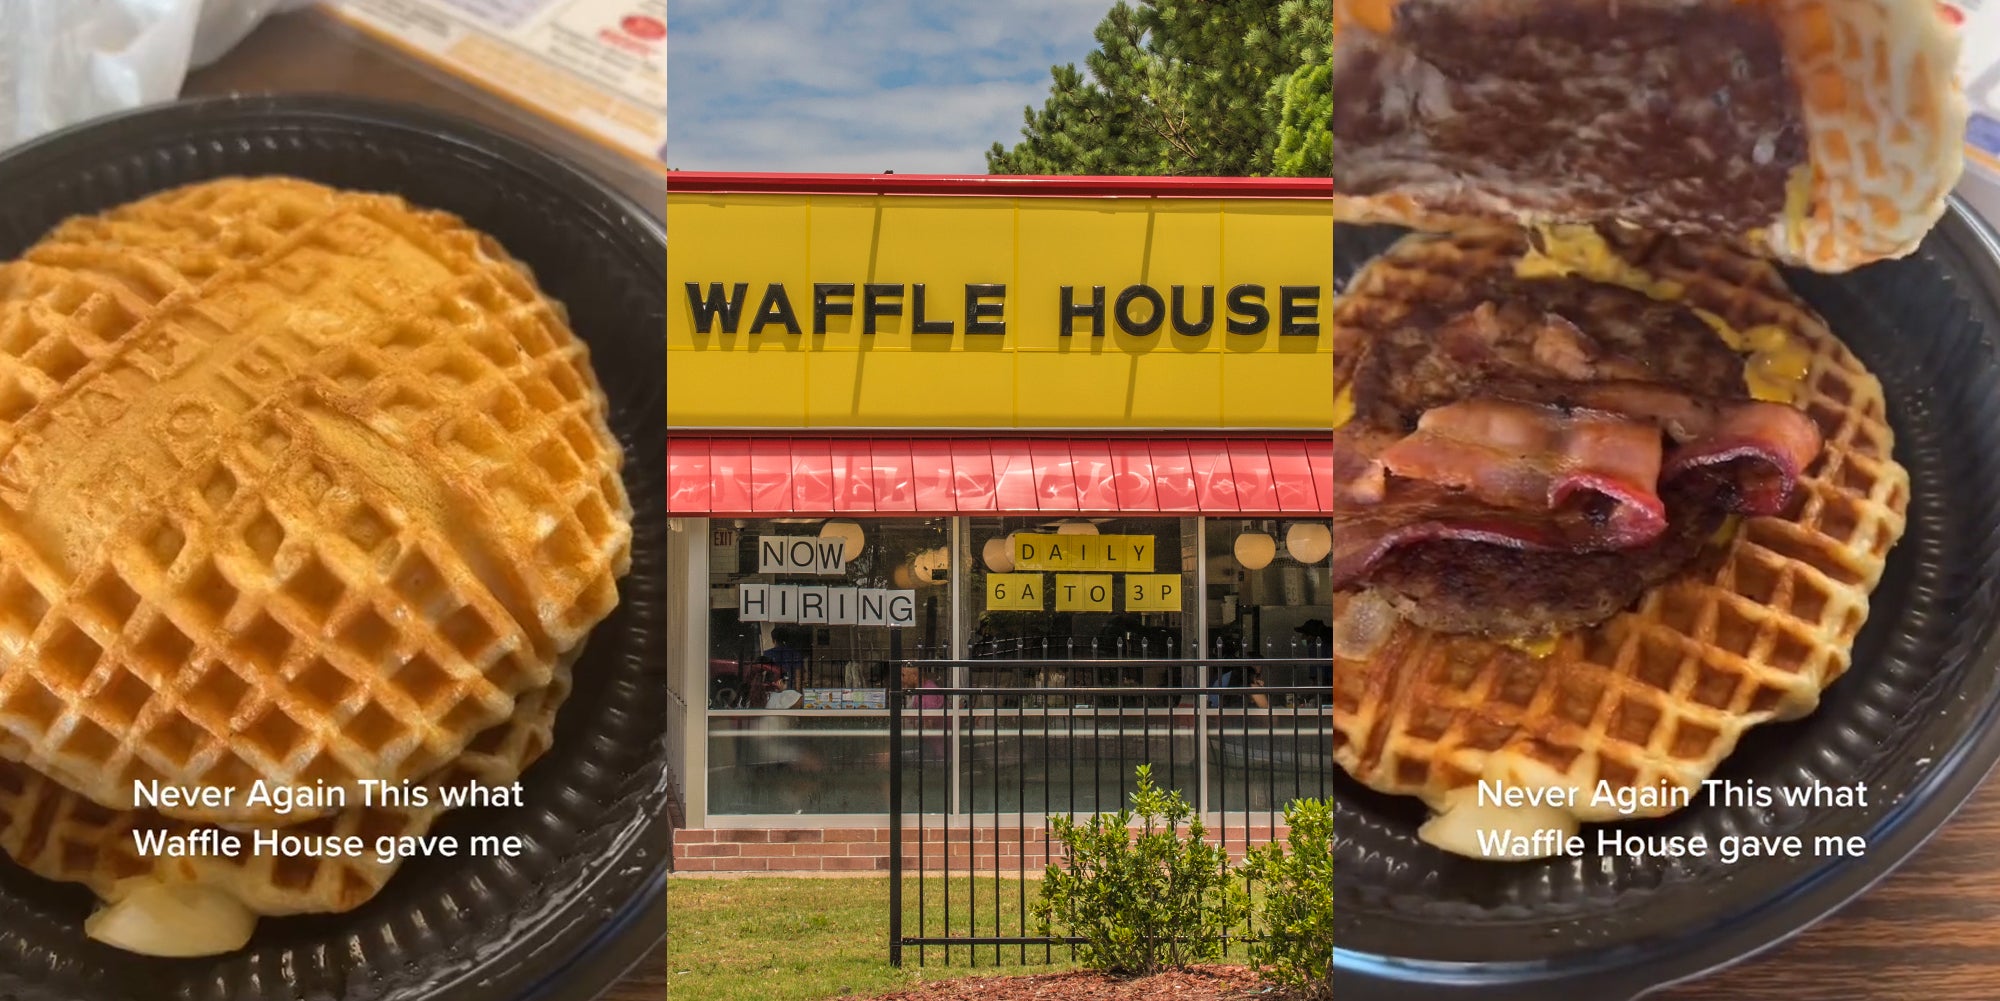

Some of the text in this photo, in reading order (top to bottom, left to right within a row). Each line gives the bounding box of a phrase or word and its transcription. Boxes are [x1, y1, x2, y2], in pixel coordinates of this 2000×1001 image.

[685, 282, 1320, 337] WAFFLE HOUSE
[714, 531, 733, 546] EXIT
[763, 541, 844, 569] NOW
[1022, 543, 1145, 562] DAILY
[744, 589, 913, 622] HIRING
[1064, 585, 1106, 603] TO
